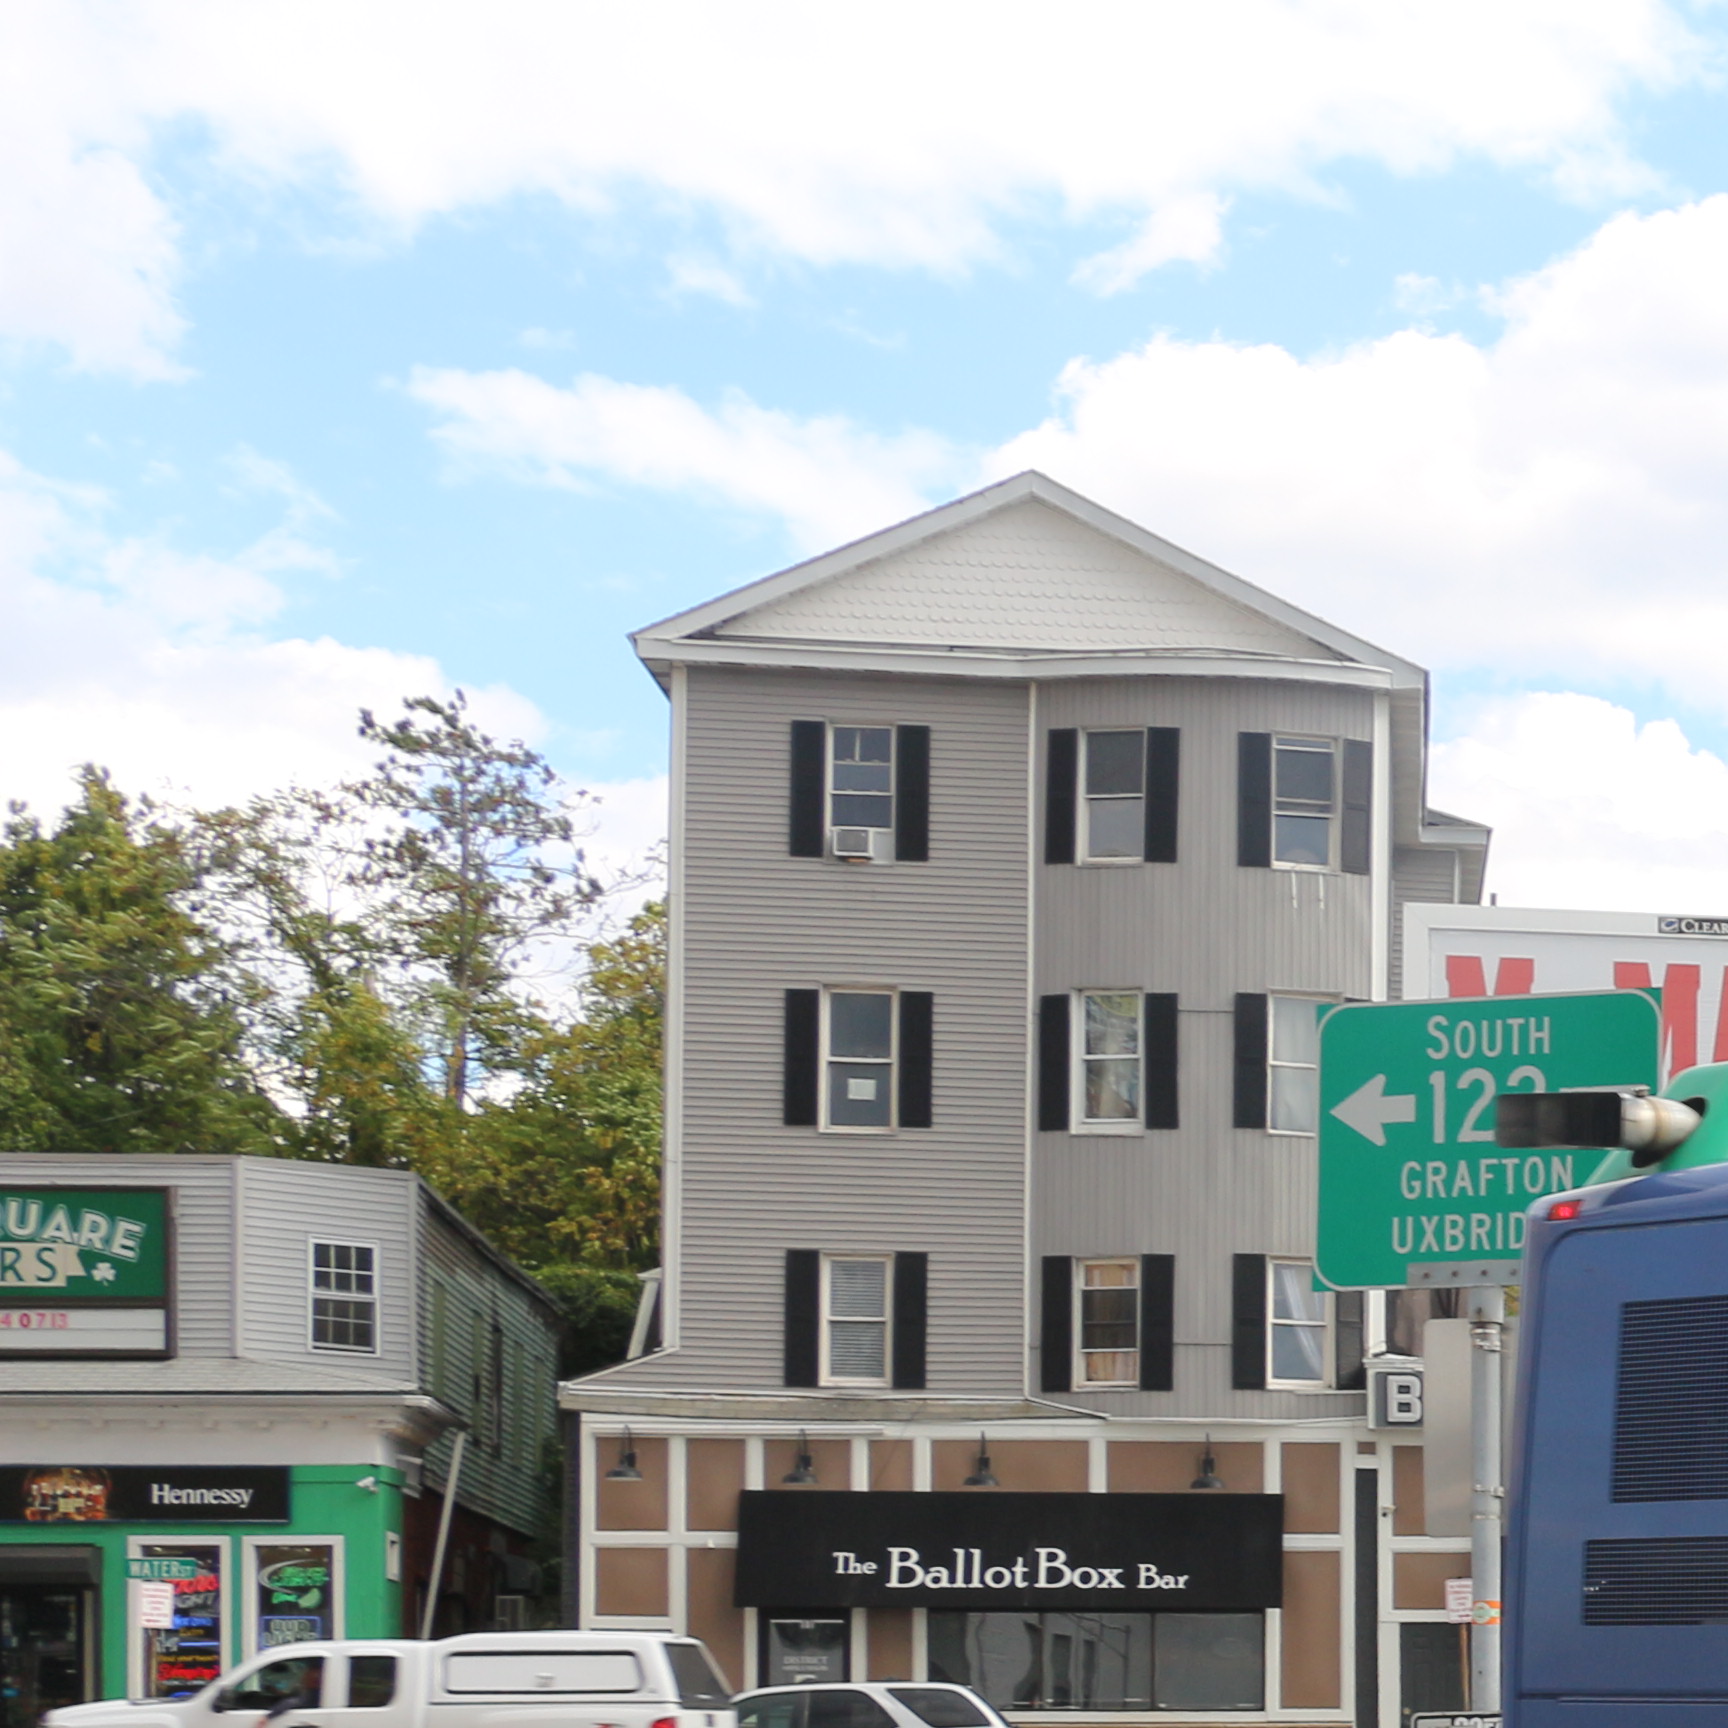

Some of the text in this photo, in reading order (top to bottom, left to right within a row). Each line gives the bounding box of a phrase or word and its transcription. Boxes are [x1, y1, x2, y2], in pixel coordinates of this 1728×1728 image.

[1426, 1014, 1550, 1060] SOUTH
[1401, 1155, 1574, 1200] GRAFTON
[0, 1197, 147, 1263] UARE
[151, 1483, 253, 1508] Hennessy
[128, 1560, 179, 1577] WATER
[833, 1547, 1190, 1589] The Ballot Box Bar
